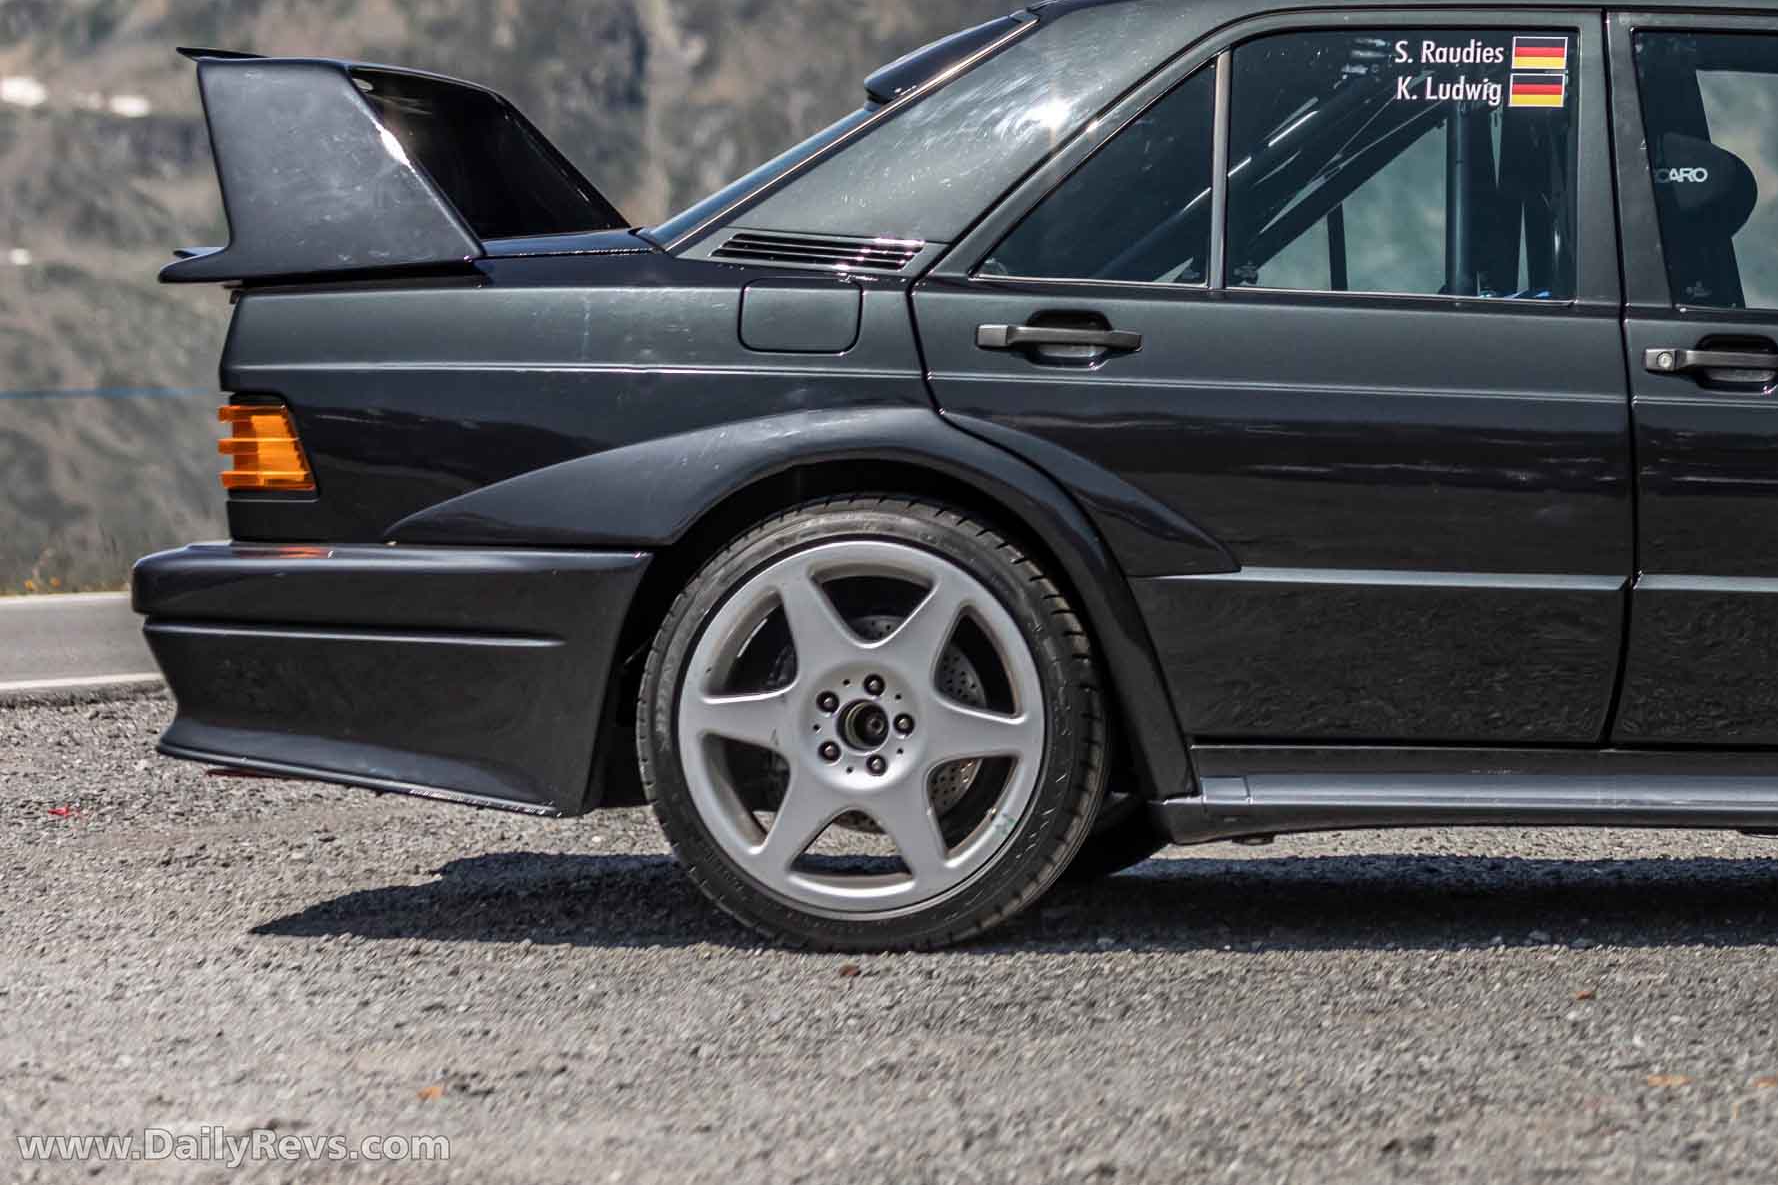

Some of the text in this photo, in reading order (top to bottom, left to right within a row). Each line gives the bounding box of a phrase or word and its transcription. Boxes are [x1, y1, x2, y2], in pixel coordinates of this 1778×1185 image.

[1394, 39, 1504, 64] S. Raudies
[1397, 75, 1502, 106] K. Ludwig
